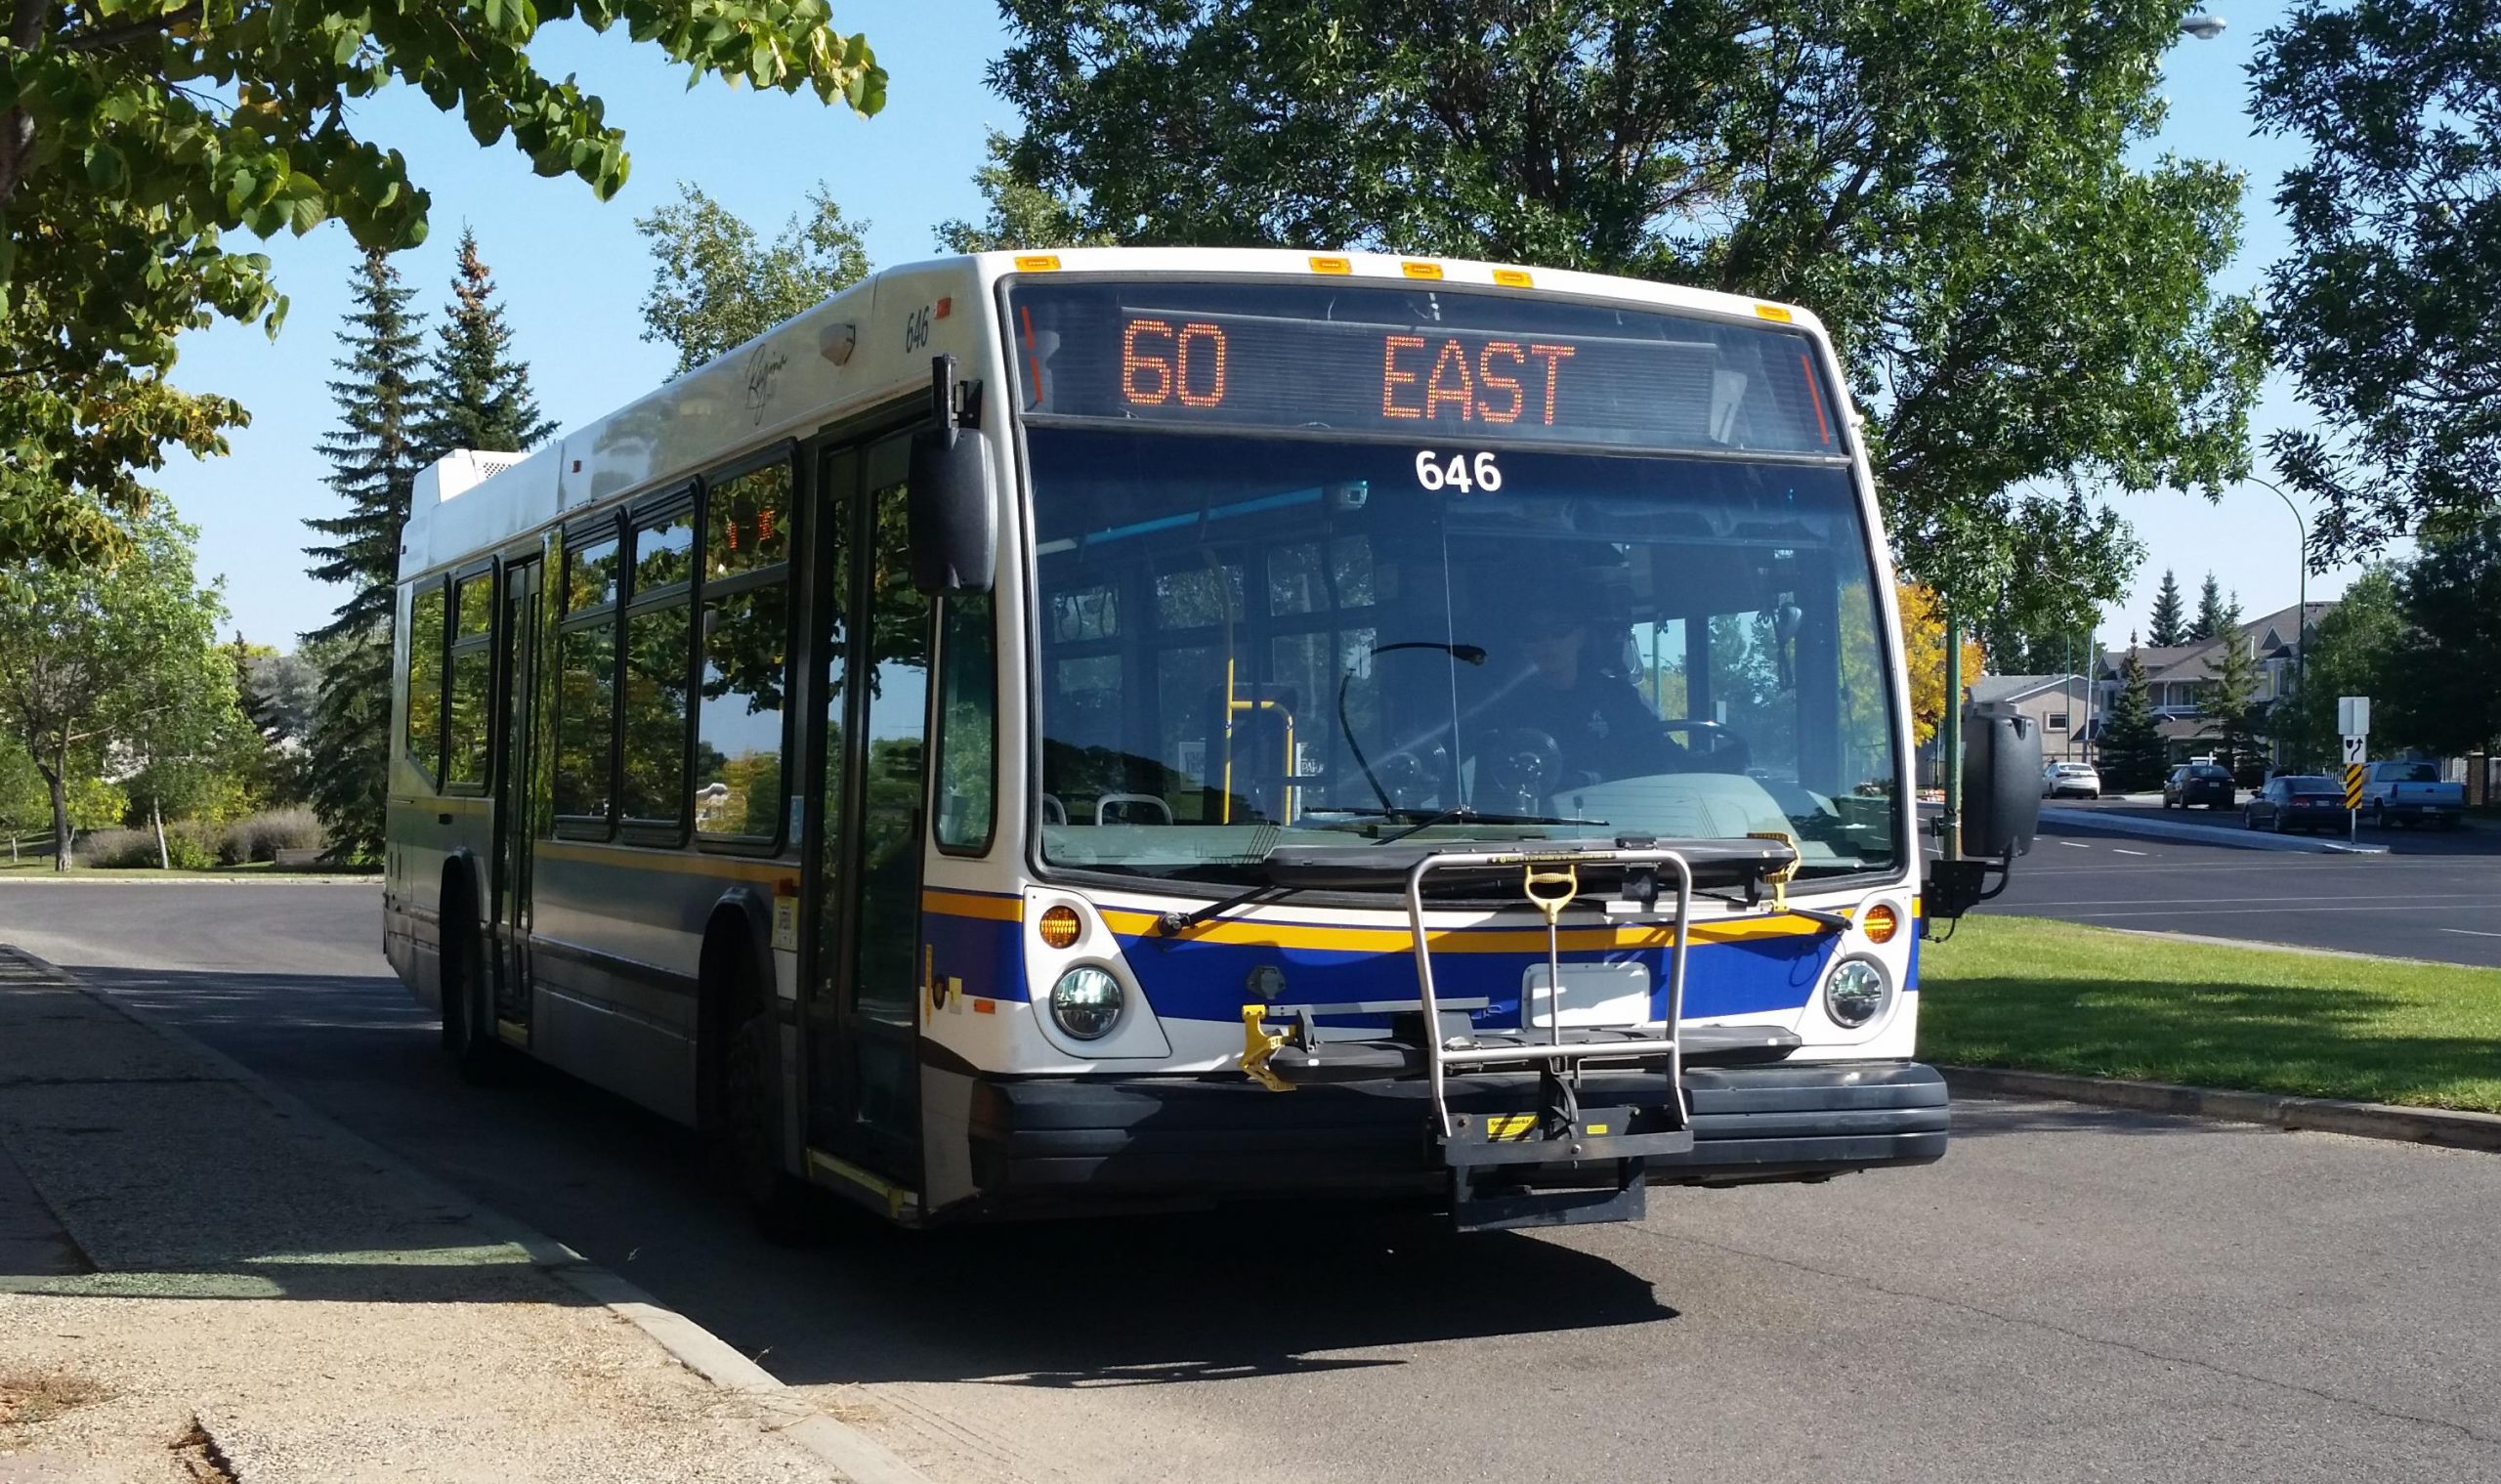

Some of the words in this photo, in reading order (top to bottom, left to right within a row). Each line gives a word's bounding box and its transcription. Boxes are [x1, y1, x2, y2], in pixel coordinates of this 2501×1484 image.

[906, 305, 929, 354] 646
[1121, 318, 1227, 408] 60
[1382, 333, 1577, 427] EAST
[1415, 449, 1503, 493] 646
